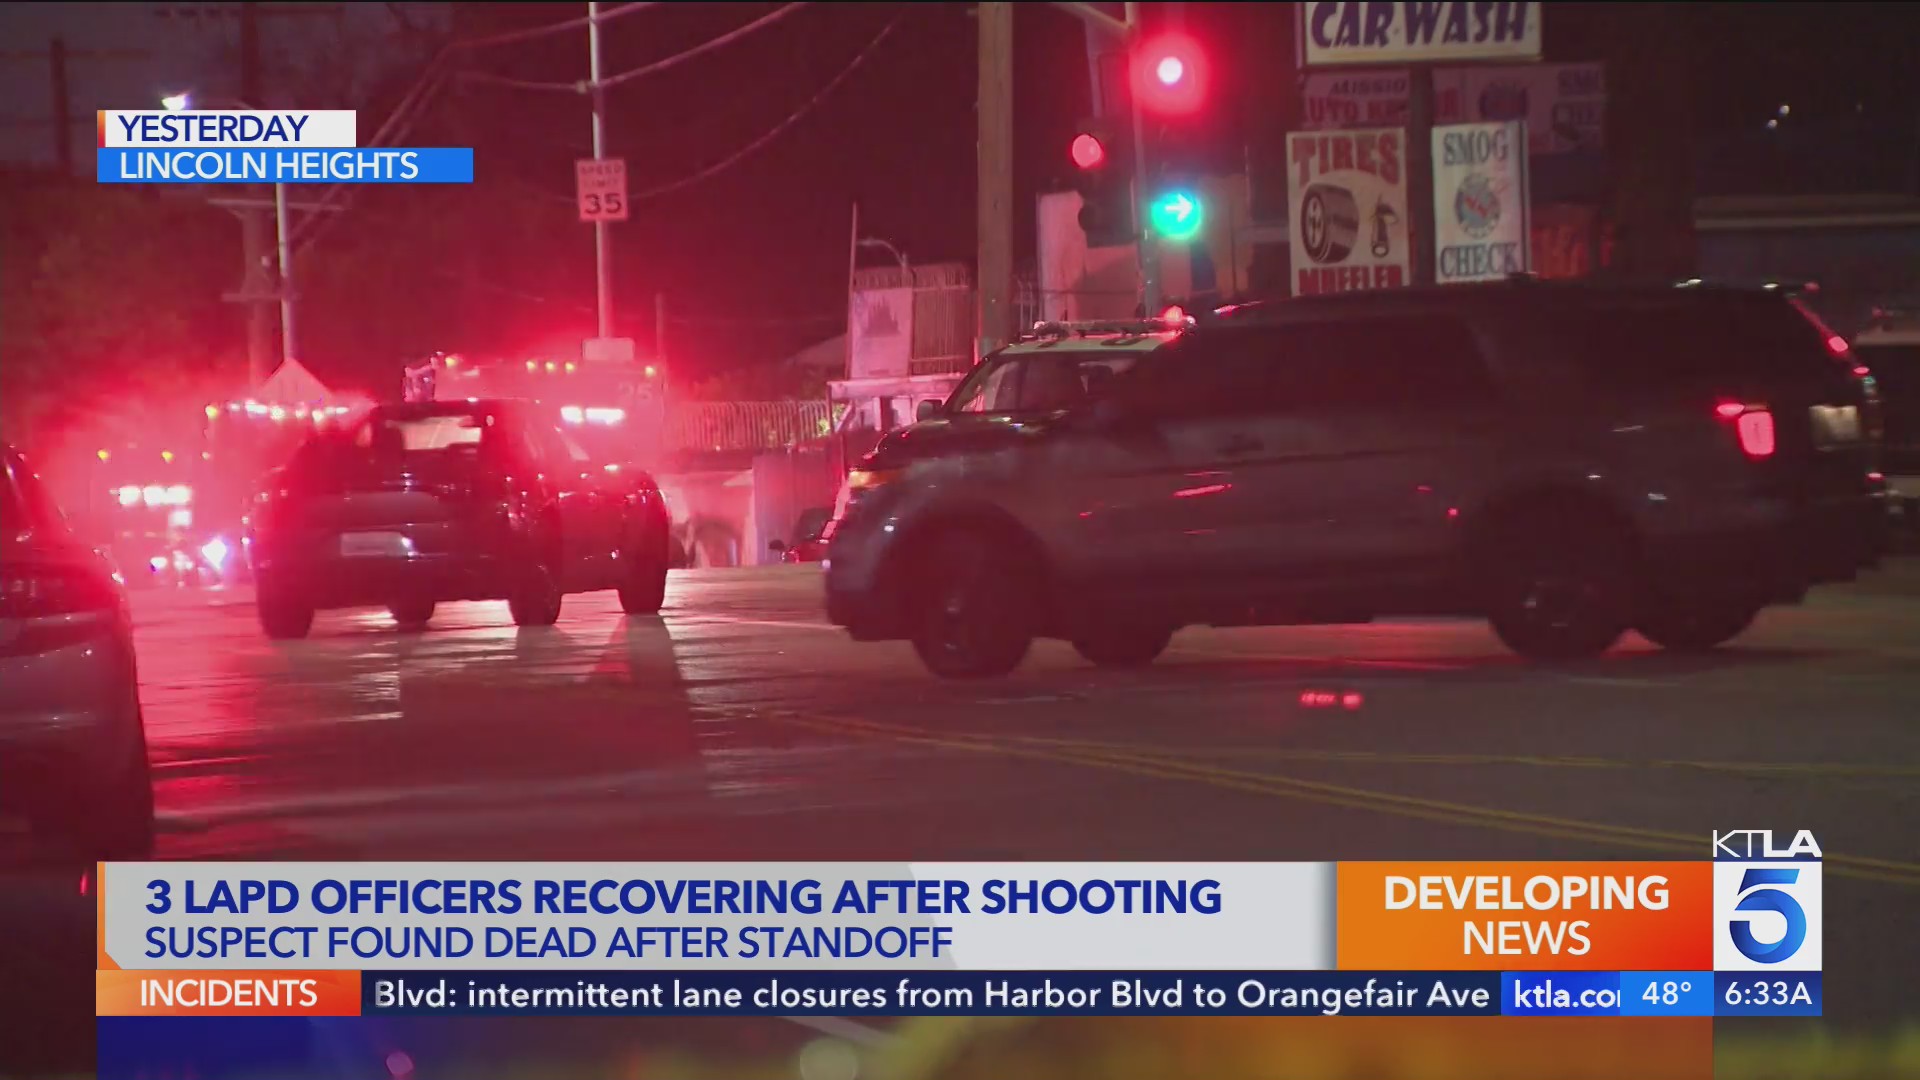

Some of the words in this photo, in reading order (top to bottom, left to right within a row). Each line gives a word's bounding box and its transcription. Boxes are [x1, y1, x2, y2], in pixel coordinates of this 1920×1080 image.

[1311, 2, 1394, 49] CAR
[1403, 2, 1529, 46] WASH
[1292, 133, 1400, 187] TIRES
[1443, 129, 1509, 167] SMOG
[584, 193, 622, 214] 35
[1440, 242, 1518, 279] CHECK
